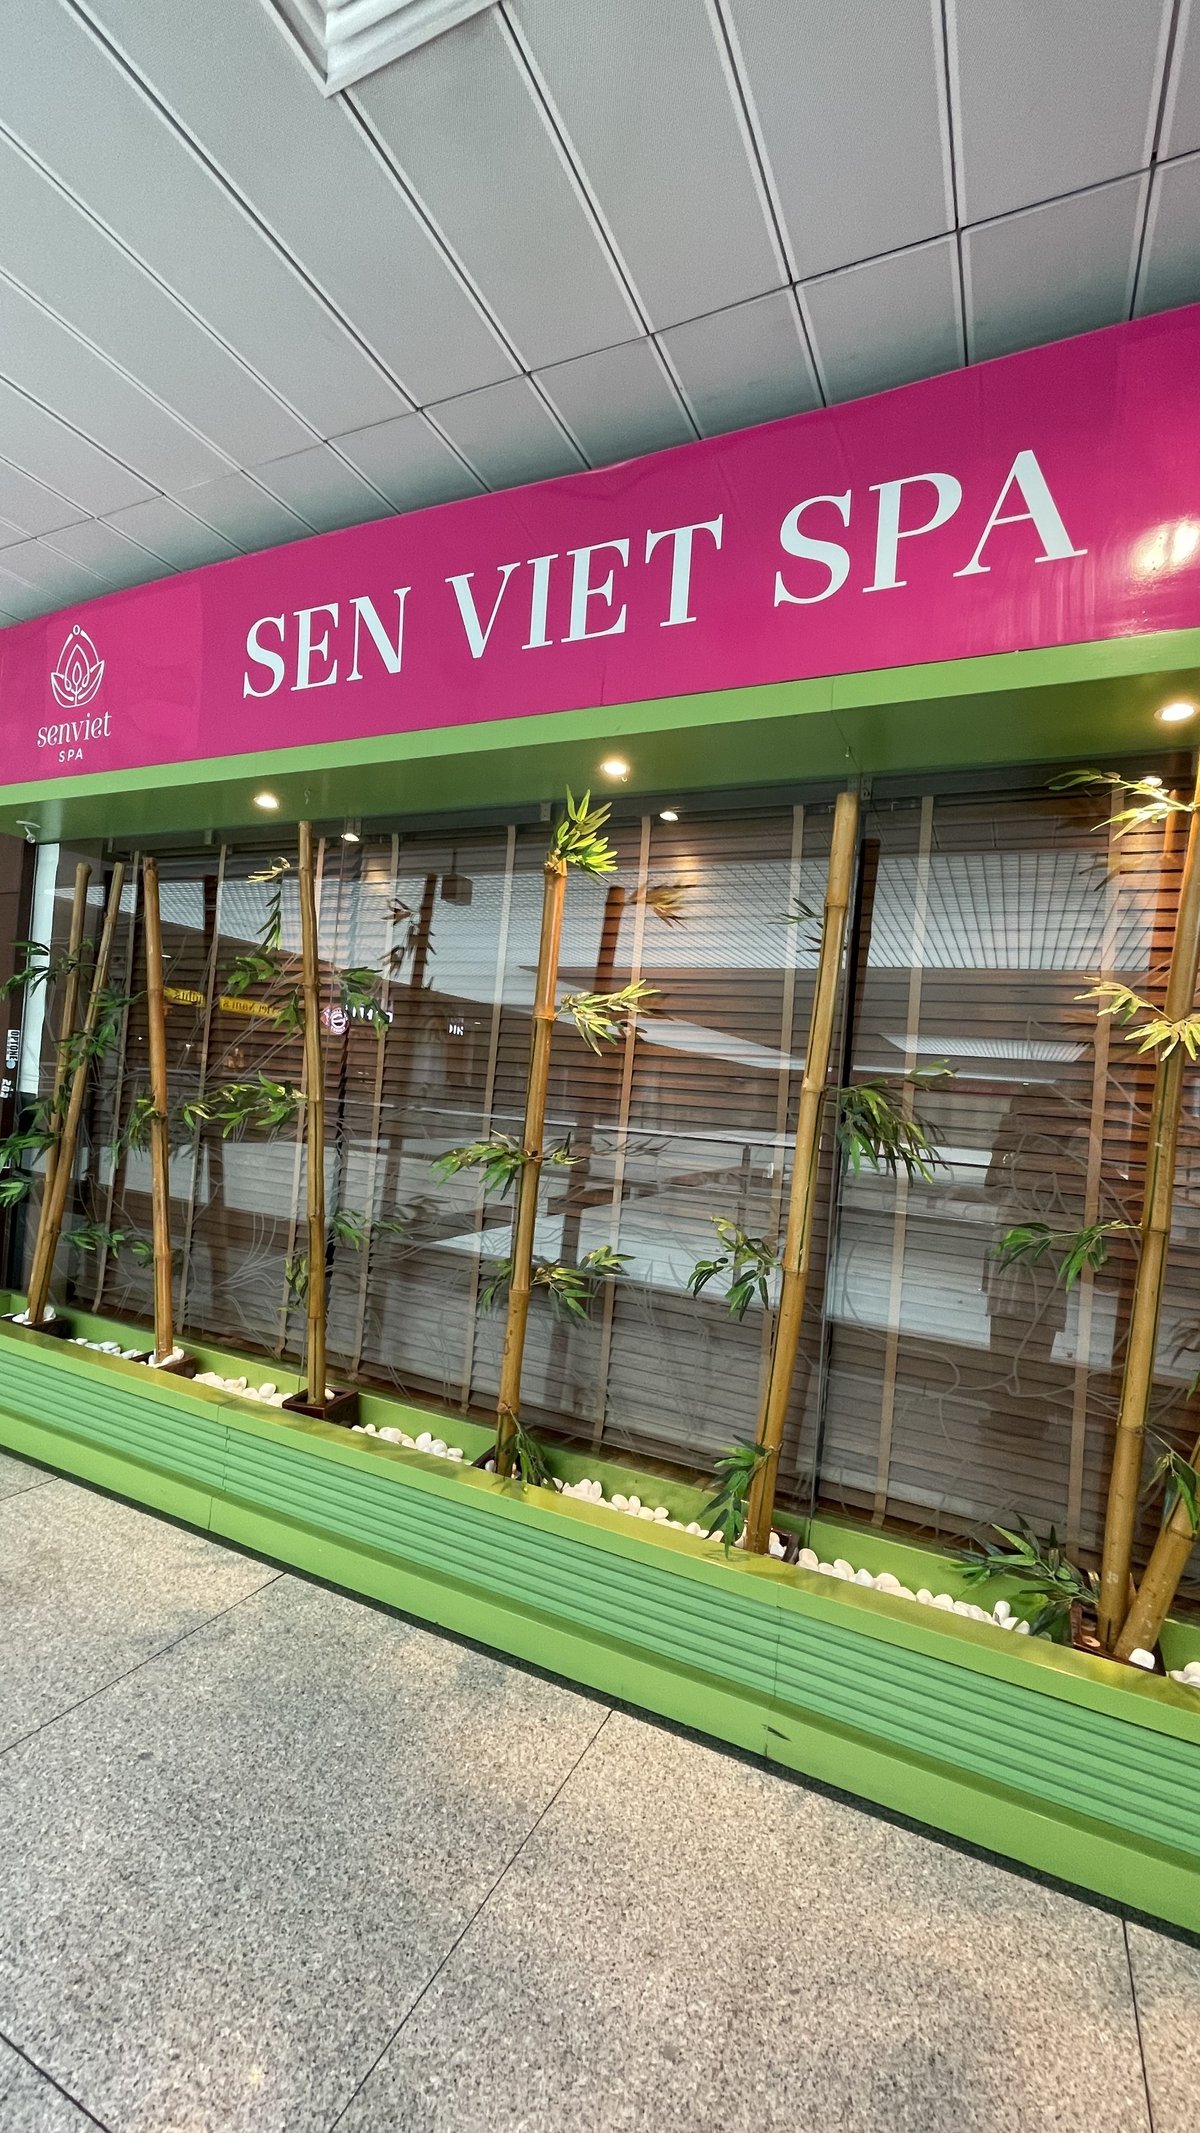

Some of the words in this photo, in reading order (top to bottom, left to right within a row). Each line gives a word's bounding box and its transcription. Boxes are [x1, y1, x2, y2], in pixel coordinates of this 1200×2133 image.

[243, 586, 411, 698] SEN
[445, 514, 724, 659] VIET
[773, 449, 1088, 607] SPA
[37, 711, 112, 748] senviet
[58, 748, 83, 763] SPA
